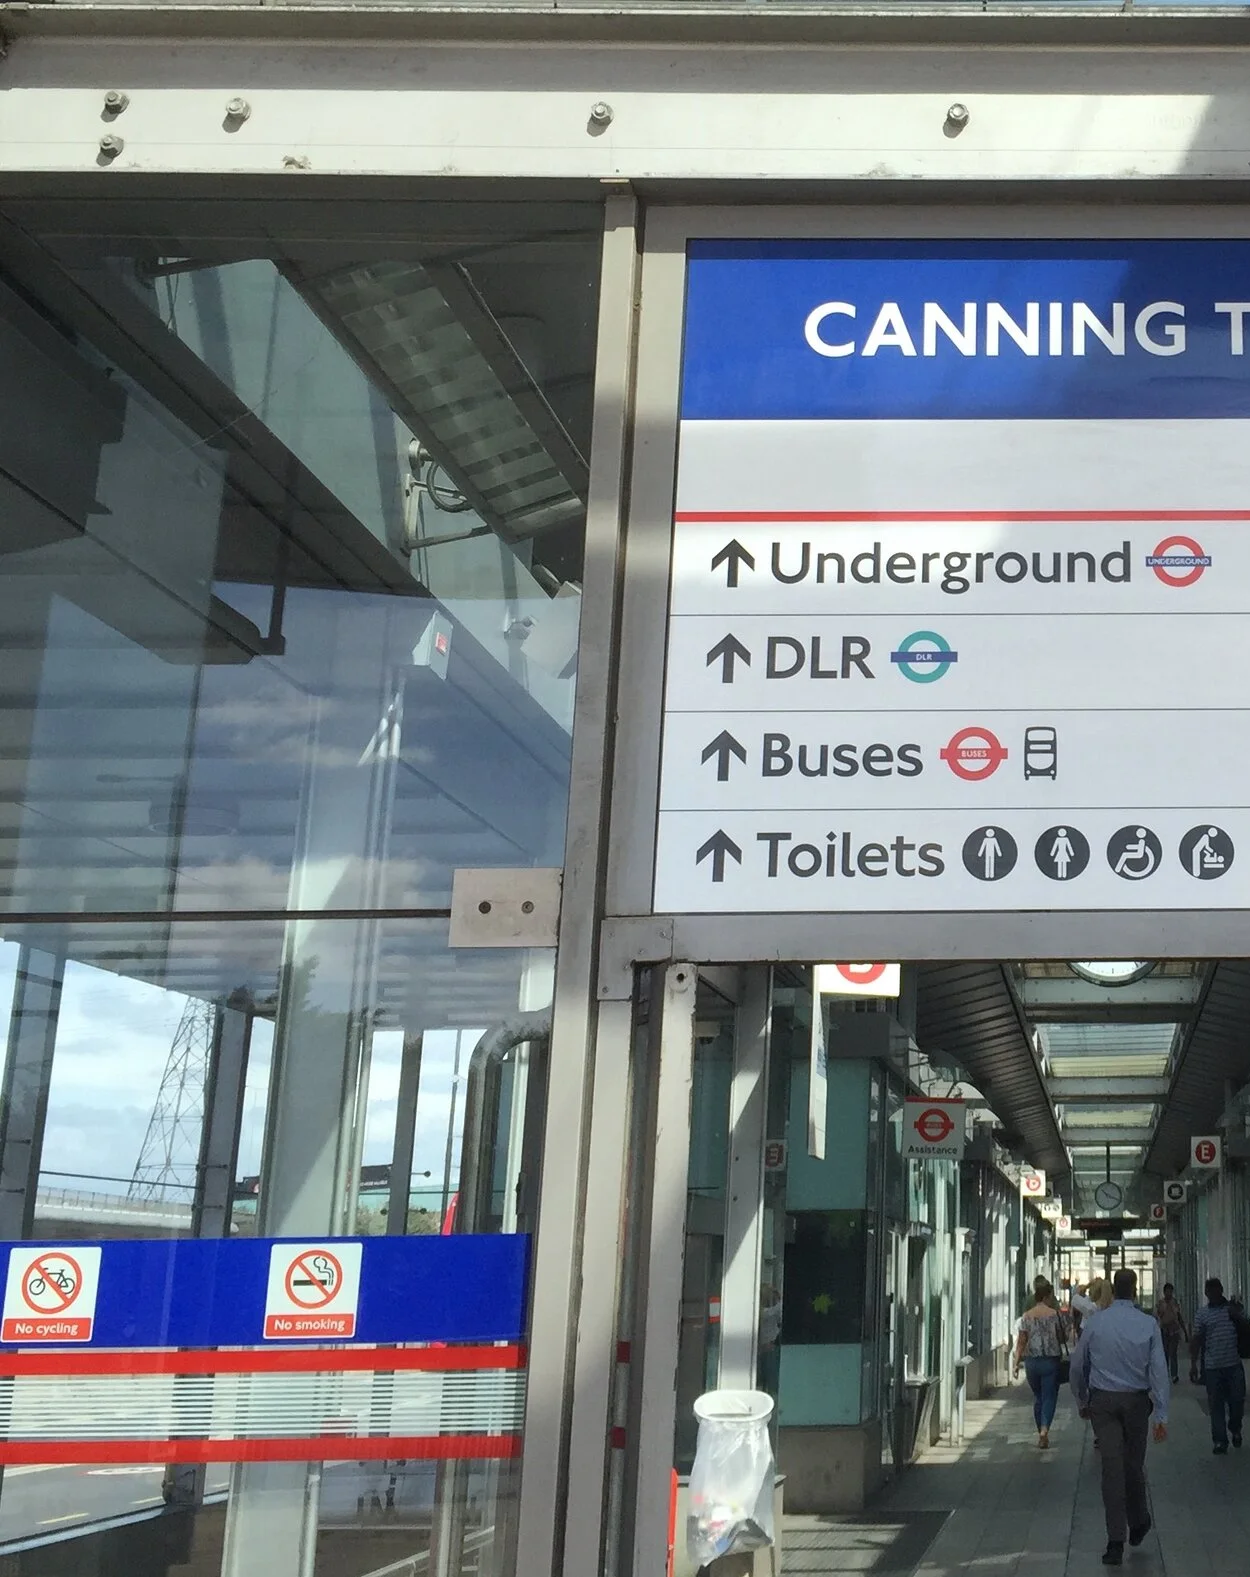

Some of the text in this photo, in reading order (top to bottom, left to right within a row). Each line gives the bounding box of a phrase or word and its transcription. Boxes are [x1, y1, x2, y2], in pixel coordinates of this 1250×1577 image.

[804, 301, 1186, 358] CANNING
[771, 540, 1132, 595] Underground
[1147, 557, 1210, 565] UNDERGROUND
[765, 635, 876, 680] DLR
[915, 653, 933, 661] DLR
[761, 732, 924, 778] Buses
[961, 750, 988, 758] BUSES
[756, 830, 945, 878] Toilets
[907, 1144, 958, 1155] Assistance
[1201, 1143, 1211, 1160] E
[14, 1322, 79, 1337] No cycling
[274, 1318, 346, 1332] No smoking
